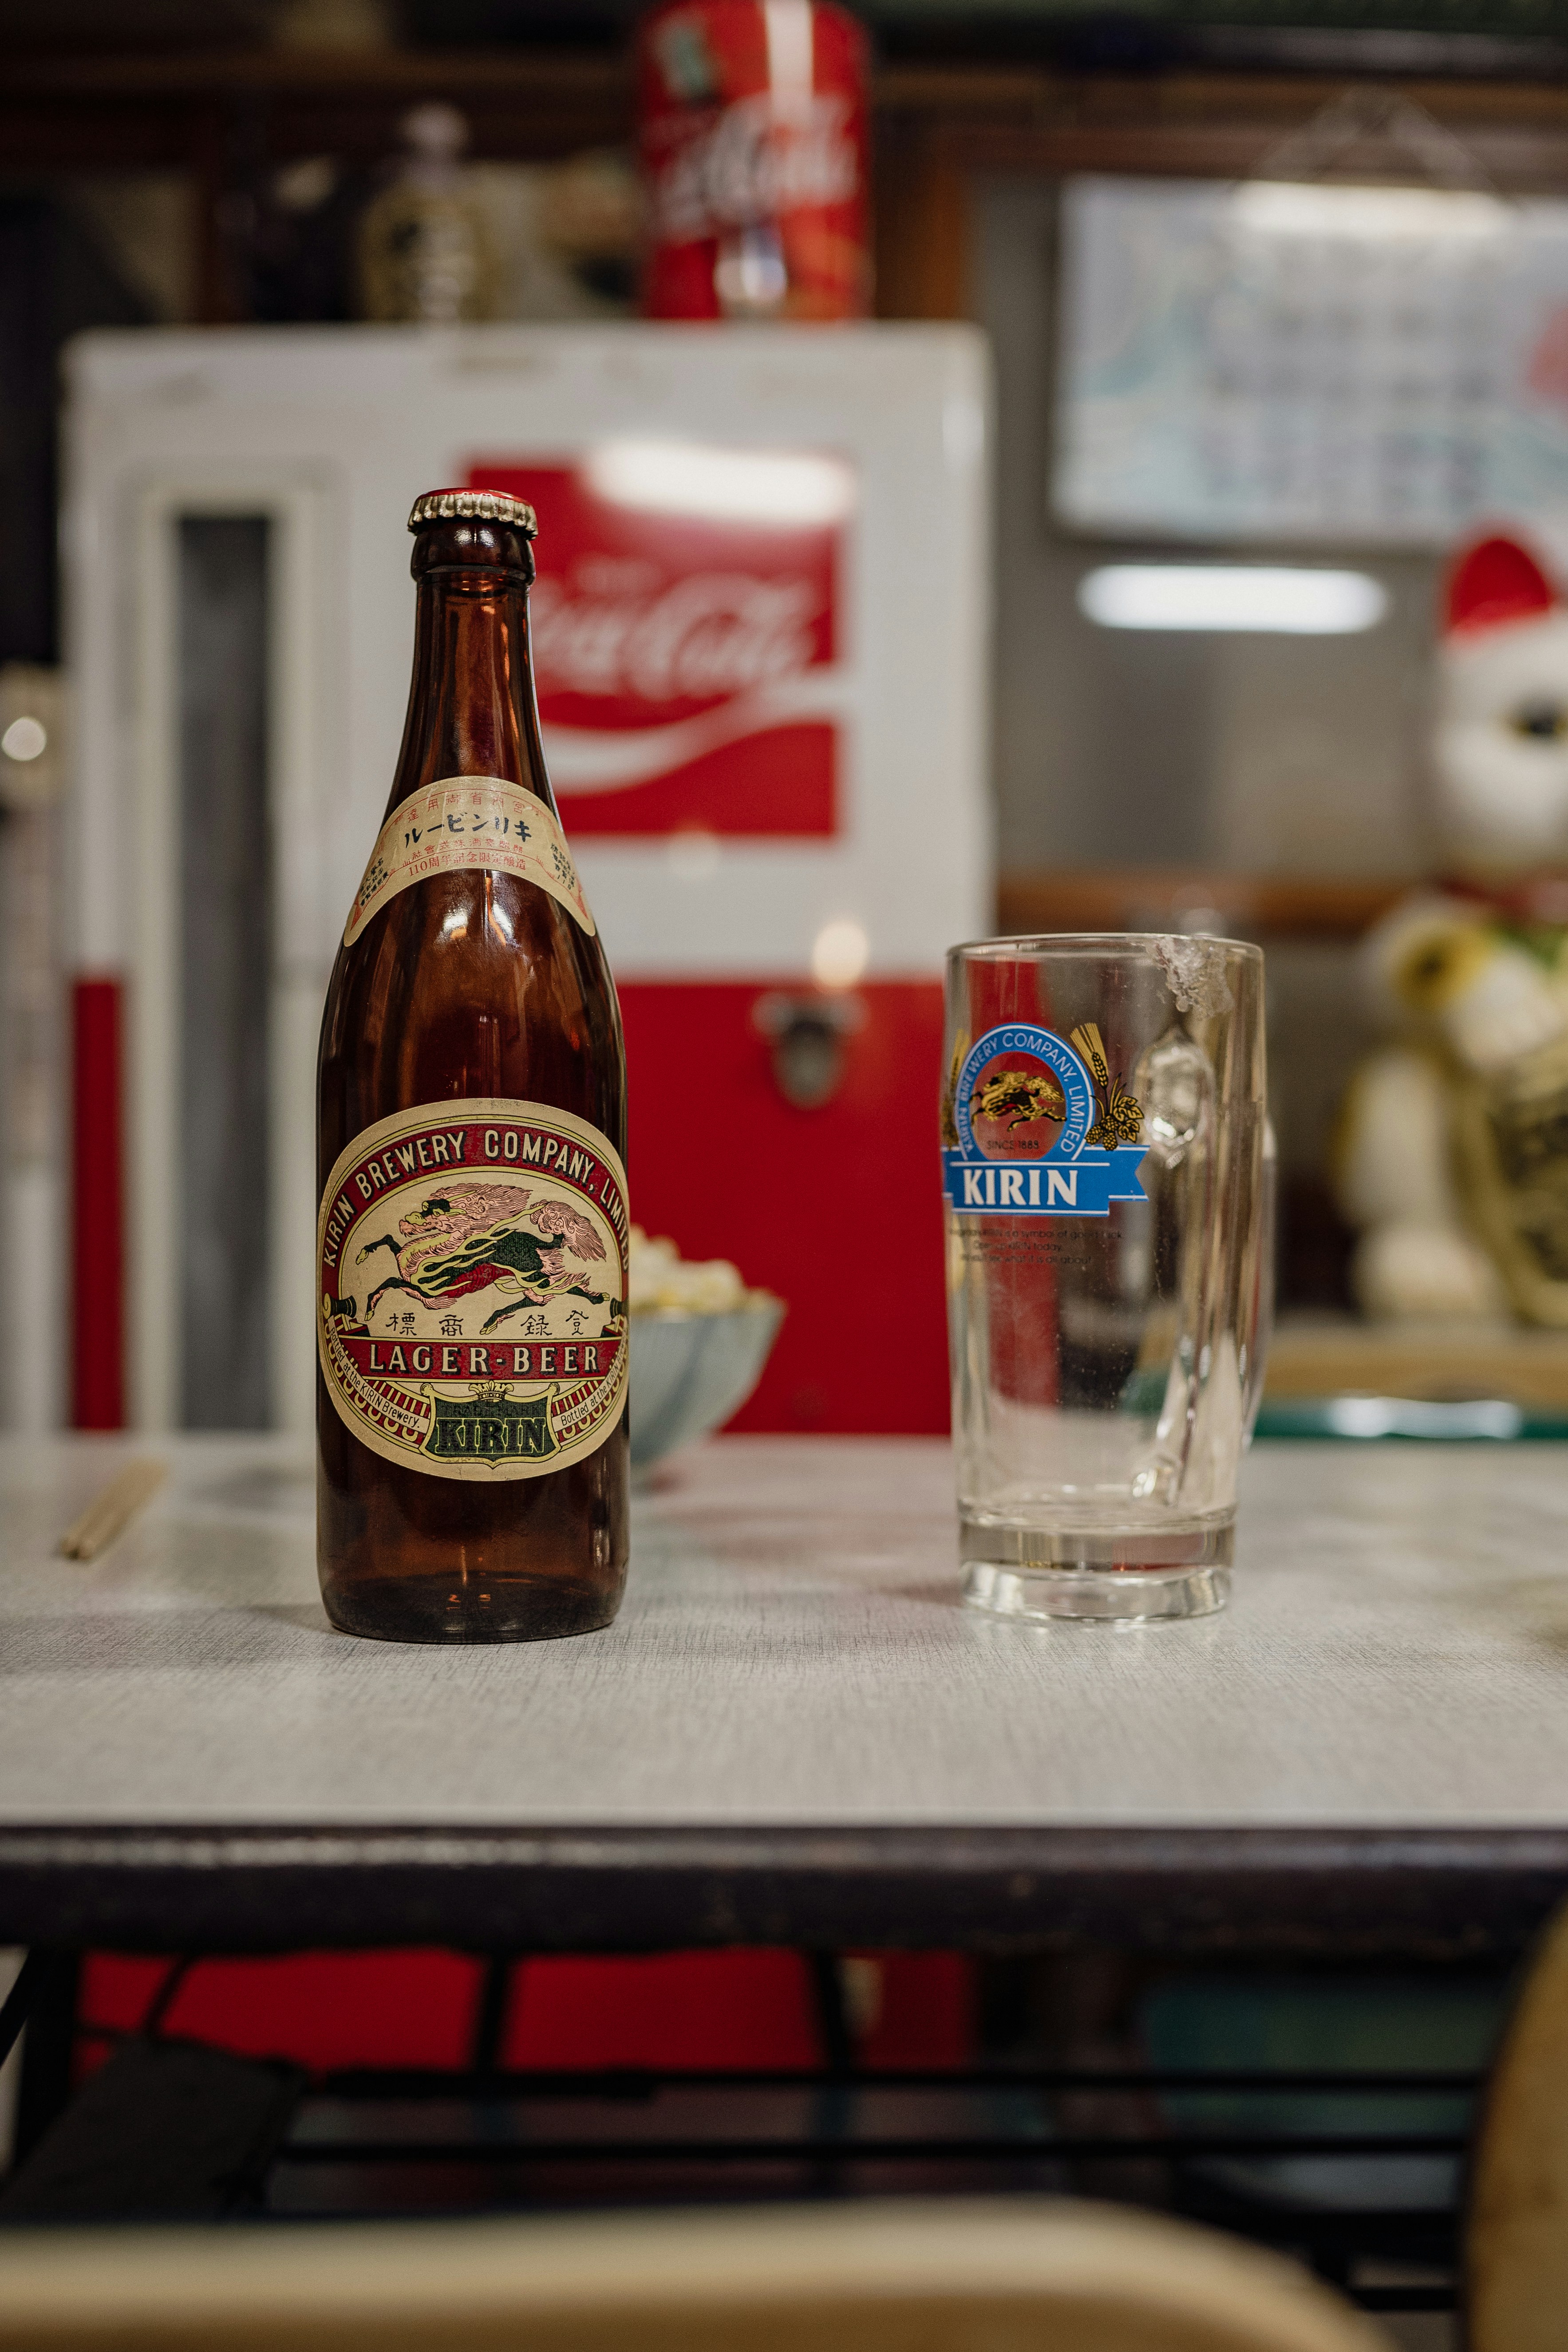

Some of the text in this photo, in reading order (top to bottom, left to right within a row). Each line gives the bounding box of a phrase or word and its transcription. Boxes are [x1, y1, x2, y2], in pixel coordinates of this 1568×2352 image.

[959, 1037, 999, 1102] BREWERY
[1002, 1032, 1078, 1082] COMPANY,
[1060, 1085, 1086, 1153] LIMITED
[986, 1139, 1014, 1150] SINCE
[324, 1194, 356, 1268] KIRIN
[355, 1131, 465, 1200] BREWERY
[485, 1130, 596, 1191] COMPANY,
[963, 1169, 1078, 1206] KIRIN
[330, 1327, 421, 1429] Bottled at the KIRIN Brewery.
[561, 1364, 619, 1427] Bottled at the KIRIN
[434, 1417, 547, 1455] KIRIN
